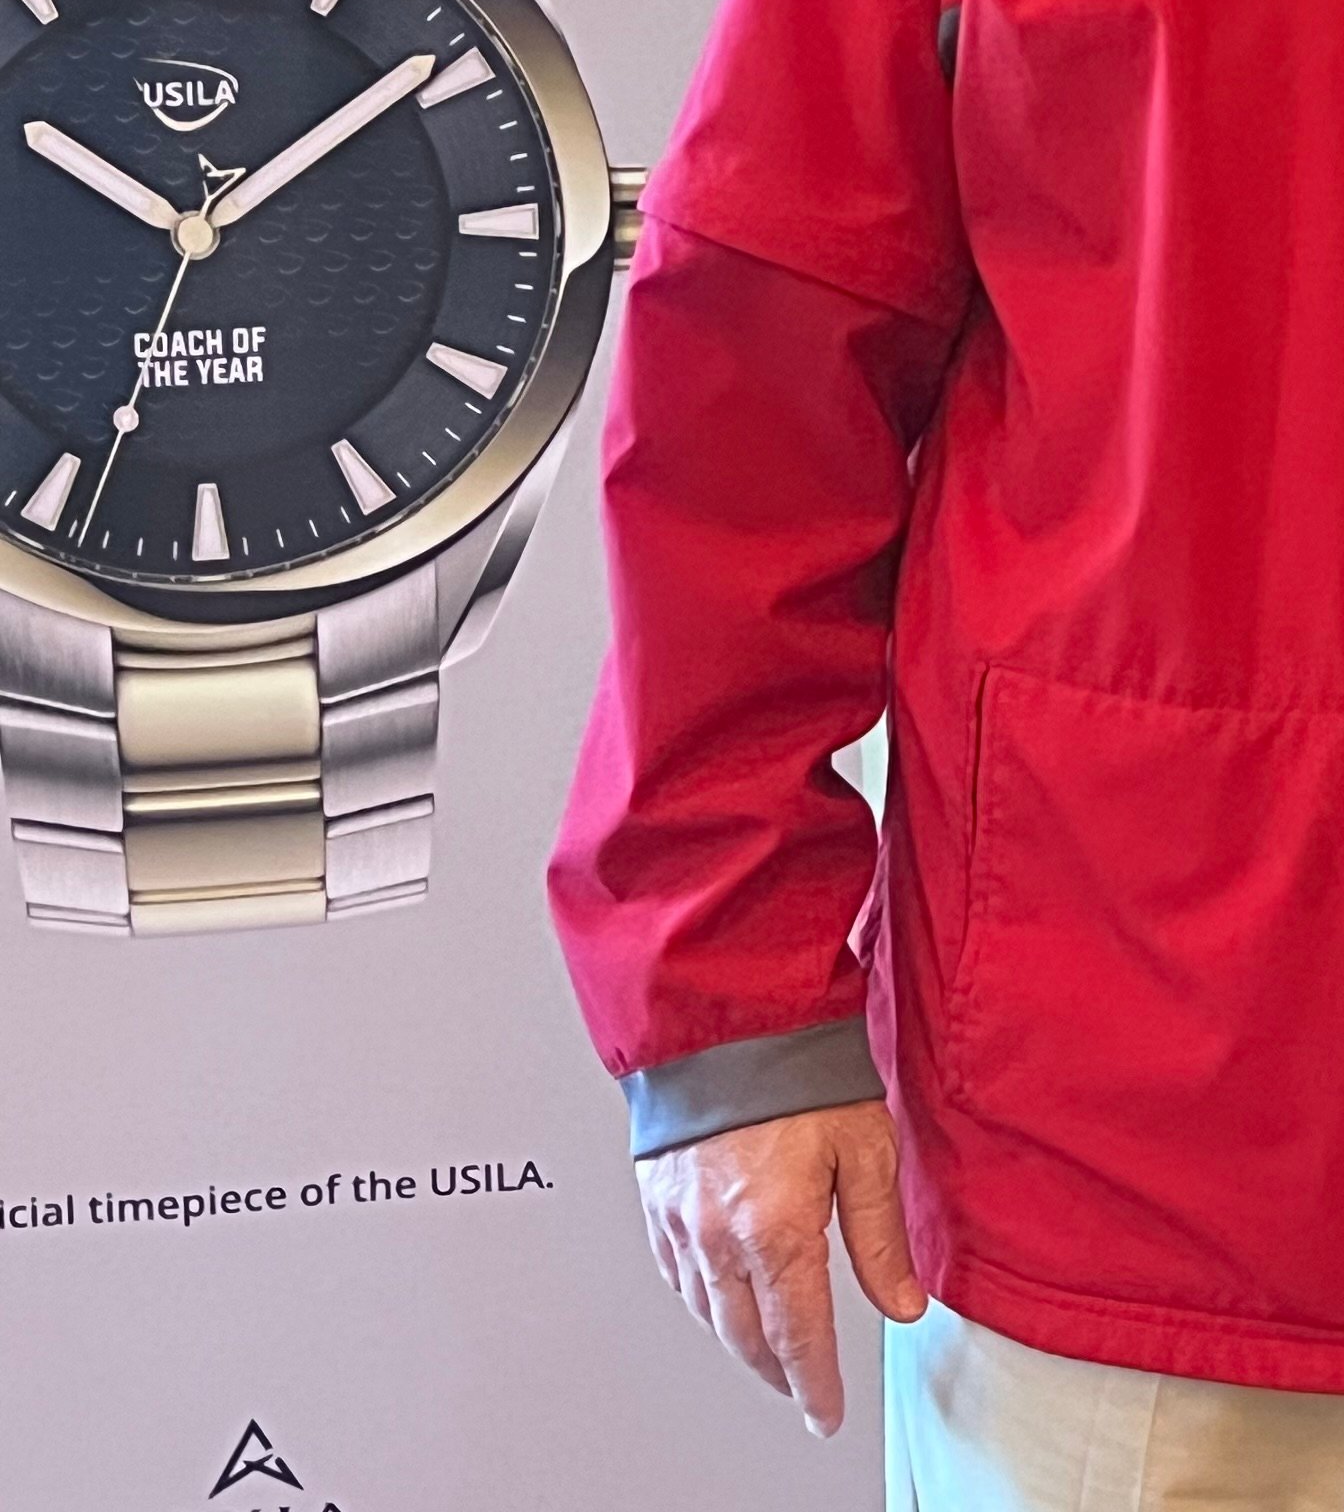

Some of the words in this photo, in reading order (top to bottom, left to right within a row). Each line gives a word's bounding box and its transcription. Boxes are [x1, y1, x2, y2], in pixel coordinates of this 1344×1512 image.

[143, 80, 236, 107] USILA
[134, 329, 223, 358] COACH
[232, 326, 266, 354] OF
[137, 360, 189, 388] THE
[196, 356, 264, 385] YEAR
[88, 1185, 287, 1227] timepiece
[300, 1173, 342, 1207] of
[352, 1170, 416, 1202] the
[430, 1160, 554, 1196] USILA.
